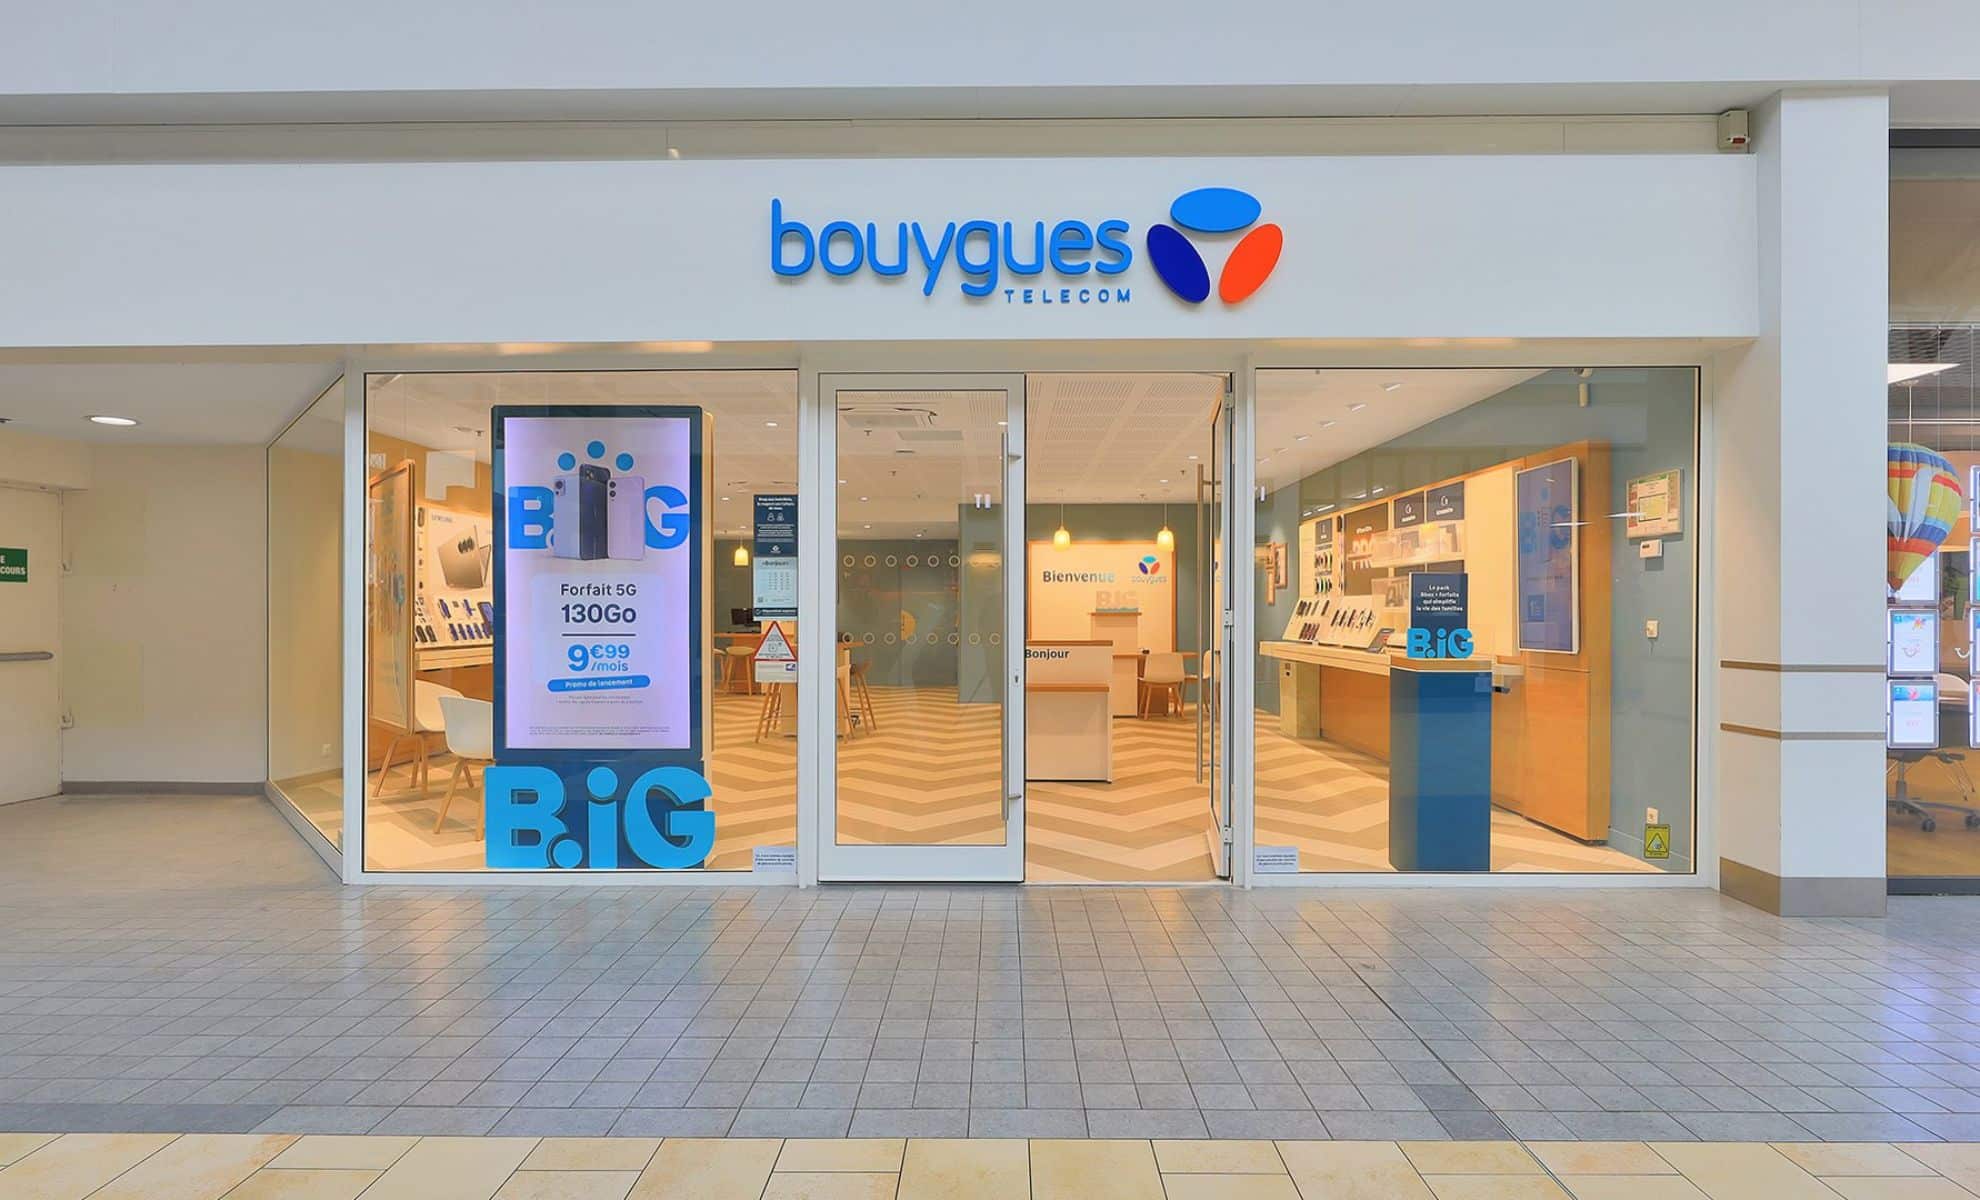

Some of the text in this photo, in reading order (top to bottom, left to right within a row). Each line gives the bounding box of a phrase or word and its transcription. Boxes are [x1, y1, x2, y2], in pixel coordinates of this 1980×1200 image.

[771, 198, 1133, 297] bouygues
[1005, 289, 1132, 304] TELECOM
[1042, 570, 1115, 583] Bienvenue
[560, 583, 637, 596] Forfait 5G
[561, 604, 637, 623] 130Go
[1025, 649, 1070, 661] Bonjour
[591, 660, 629, 672] /mois
[565, 678, 633, 689] Promo de lancement
